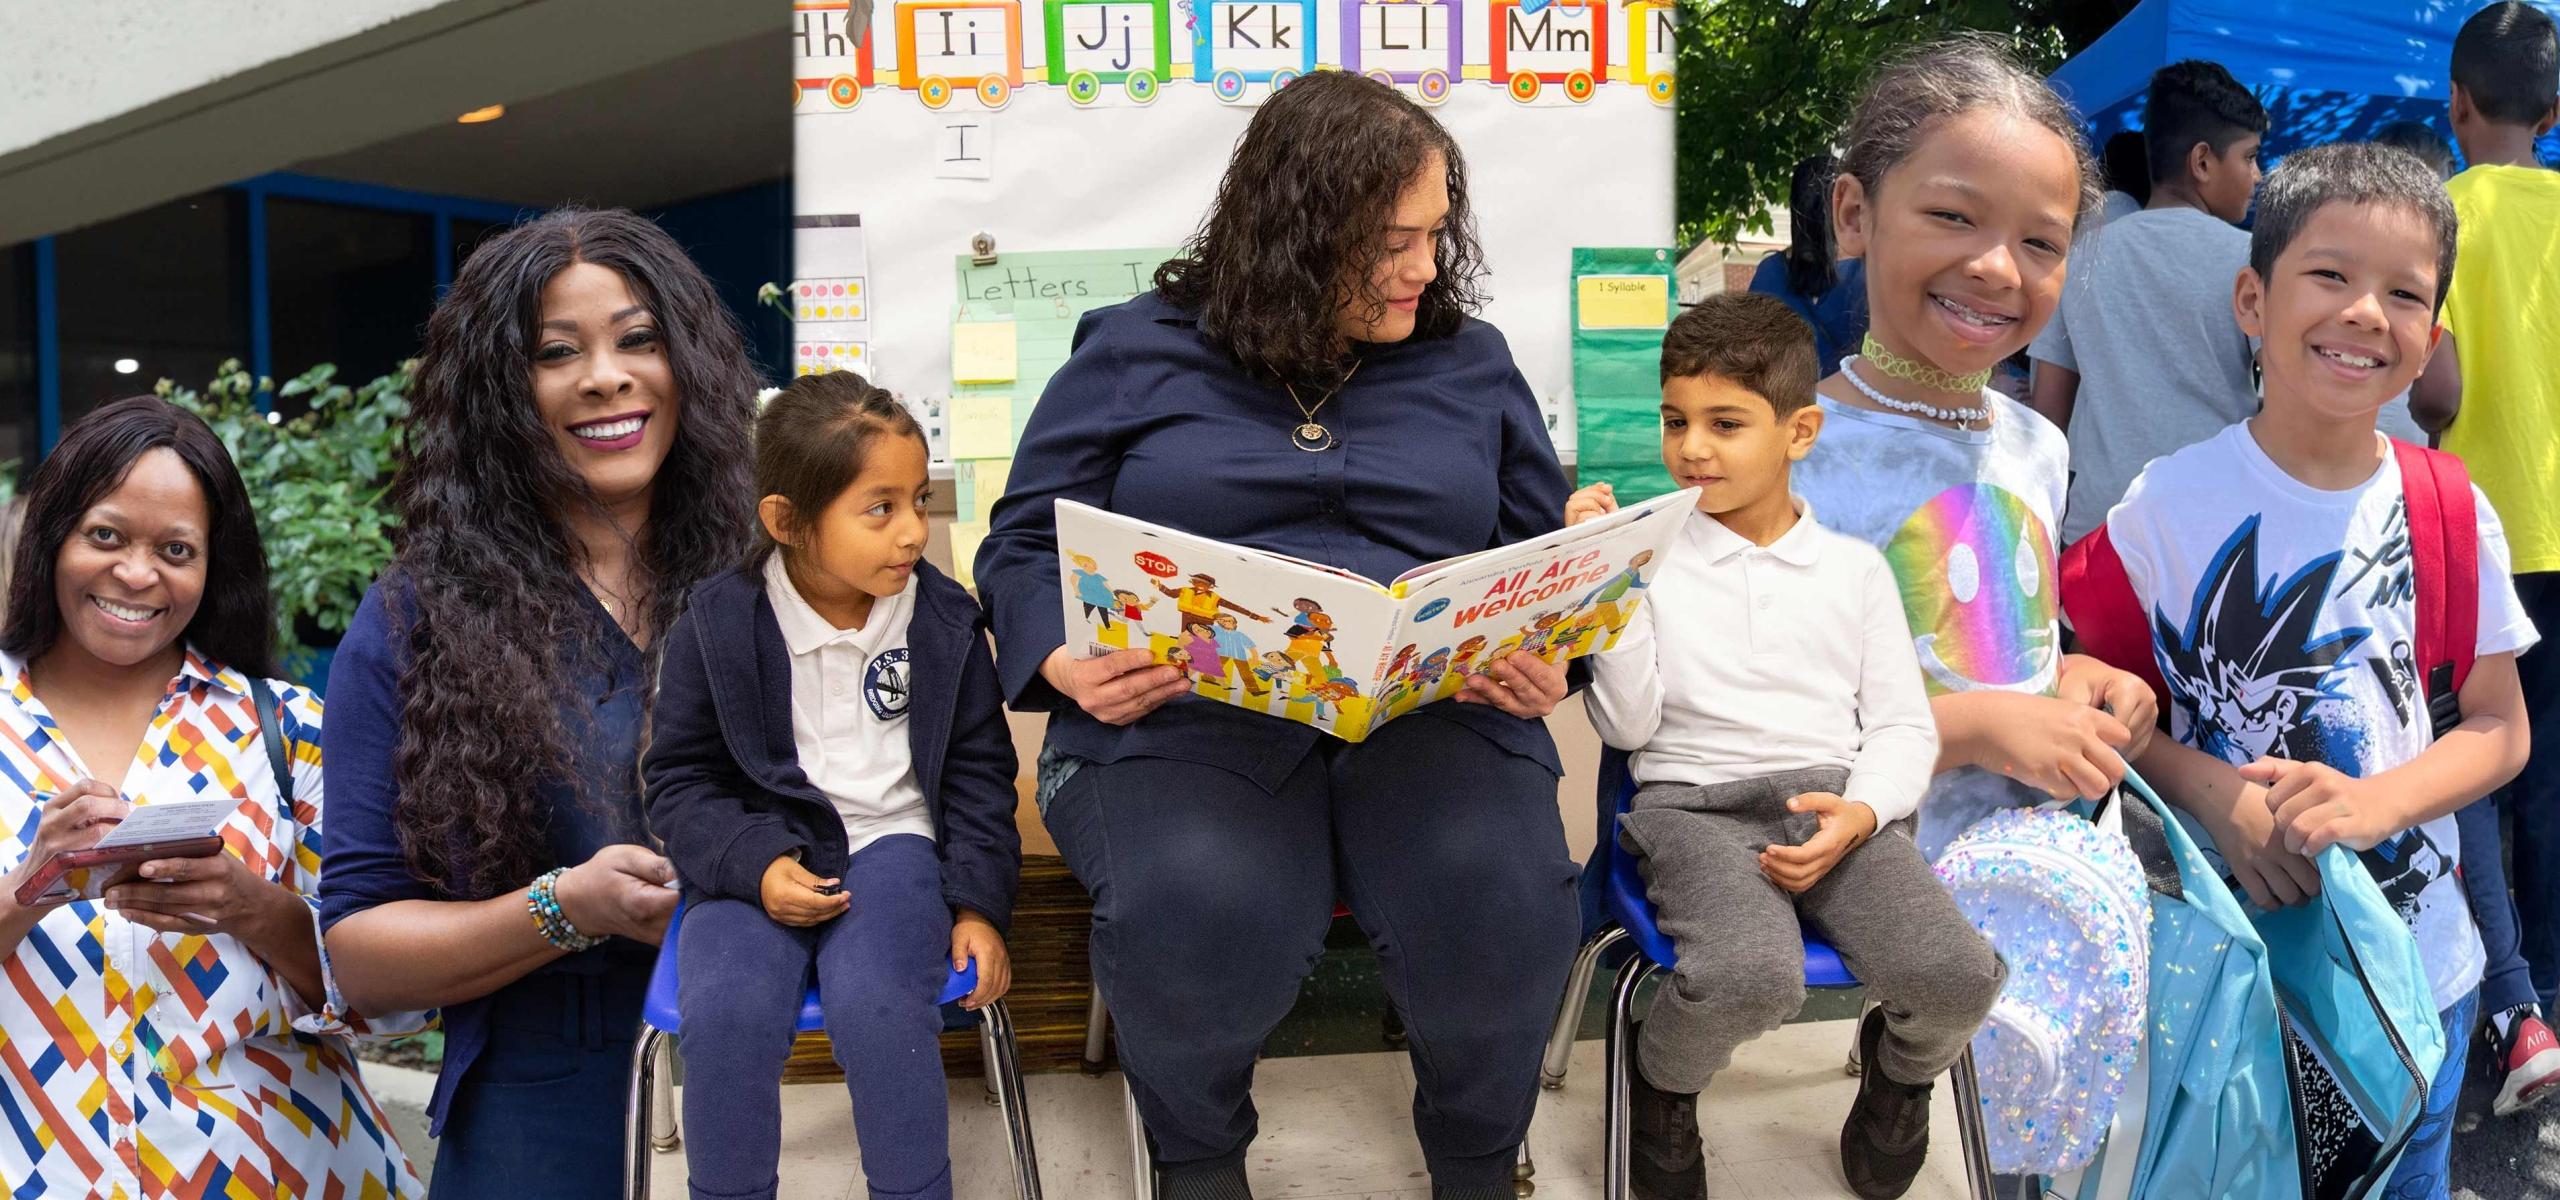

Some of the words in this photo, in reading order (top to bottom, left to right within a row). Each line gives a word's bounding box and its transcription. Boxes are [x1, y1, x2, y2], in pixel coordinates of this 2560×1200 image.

[944, 124, 981, 161] I
[963, 266, 1088, 301] Letters
[1607, 282, 1647, 294] Syllable
[1136, 555, 1176, 573] STOP
[1484, 569, 1531, 599] All
[1537, 550, 1601, 583] Are
[872, 651, 898, 672] P.S.
[2527, 1030, 2549, 1050] AIR
